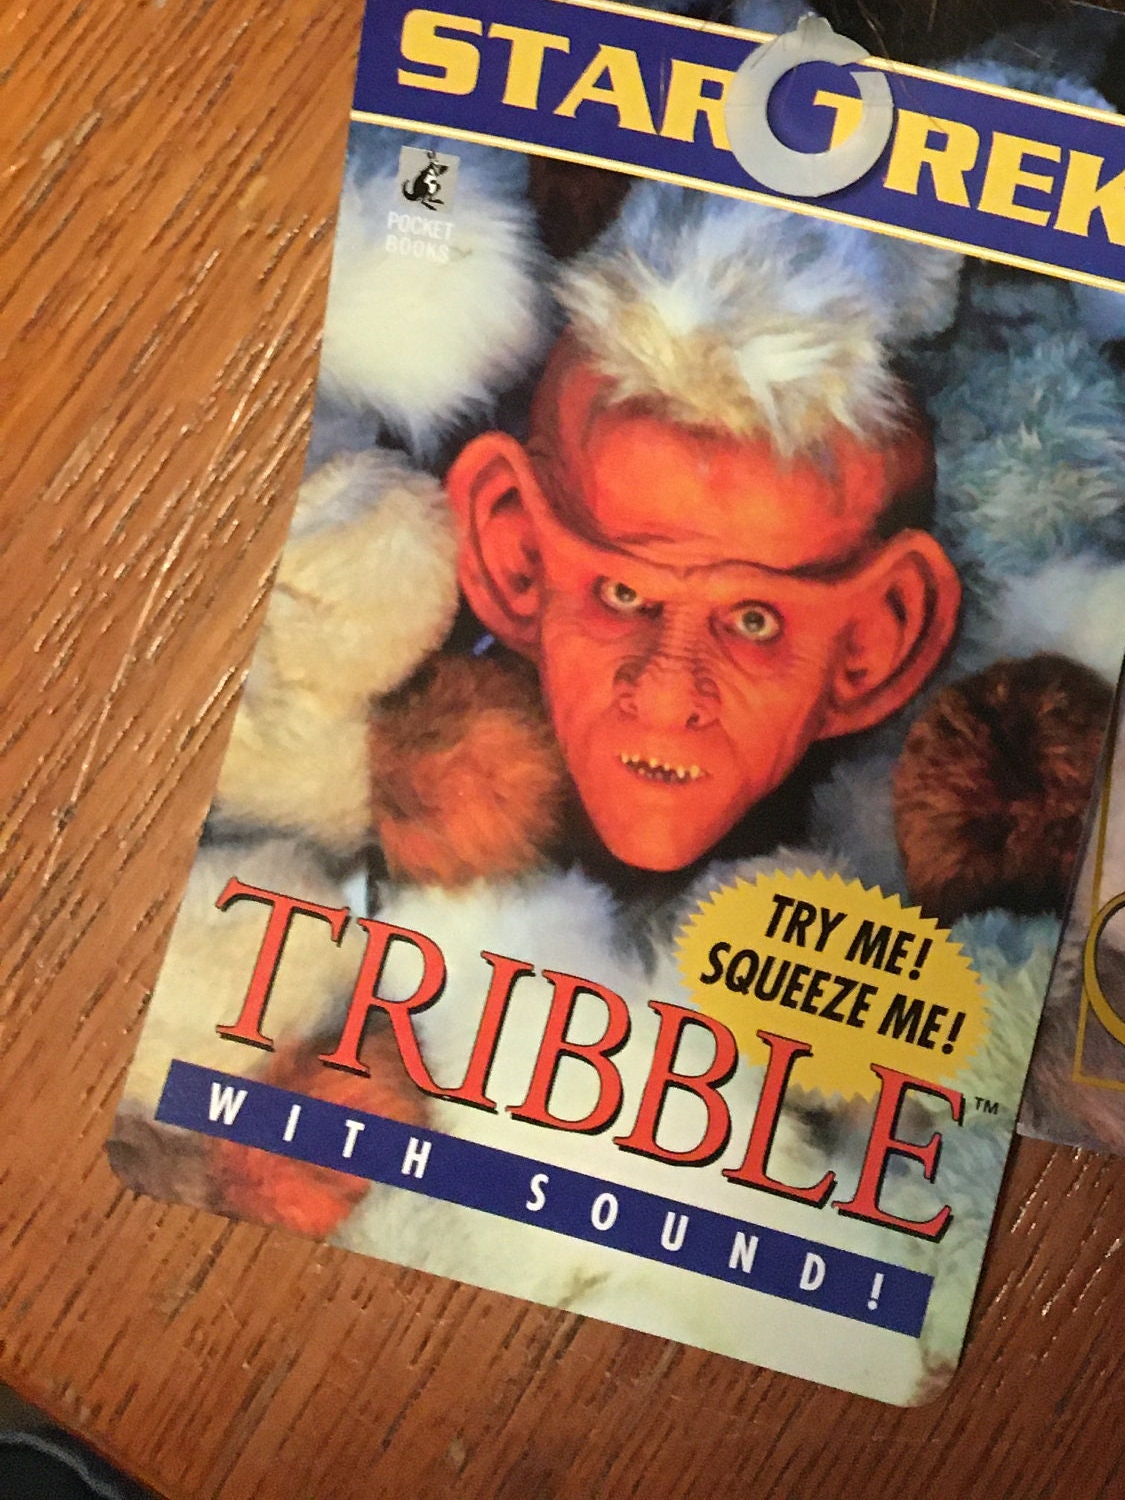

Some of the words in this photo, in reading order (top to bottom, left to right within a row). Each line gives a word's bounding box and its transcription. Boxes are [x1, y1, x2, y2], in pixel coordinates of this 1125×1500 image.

[397, 9, 735, 152] STAR
[384, 234, 450, 265] BOOKS
[387, 211, 455, 241] POCKET
[764, 892, 846, 953] TRY
[846, 924, 931, 981] ME!
[700, 940, 876, 1027] SQUEEZE
[886, 993, 968, 1055] ME!
[207, 1080, 433, 1180] WITH
[524, 1171, 887, 1312] SOUND!
